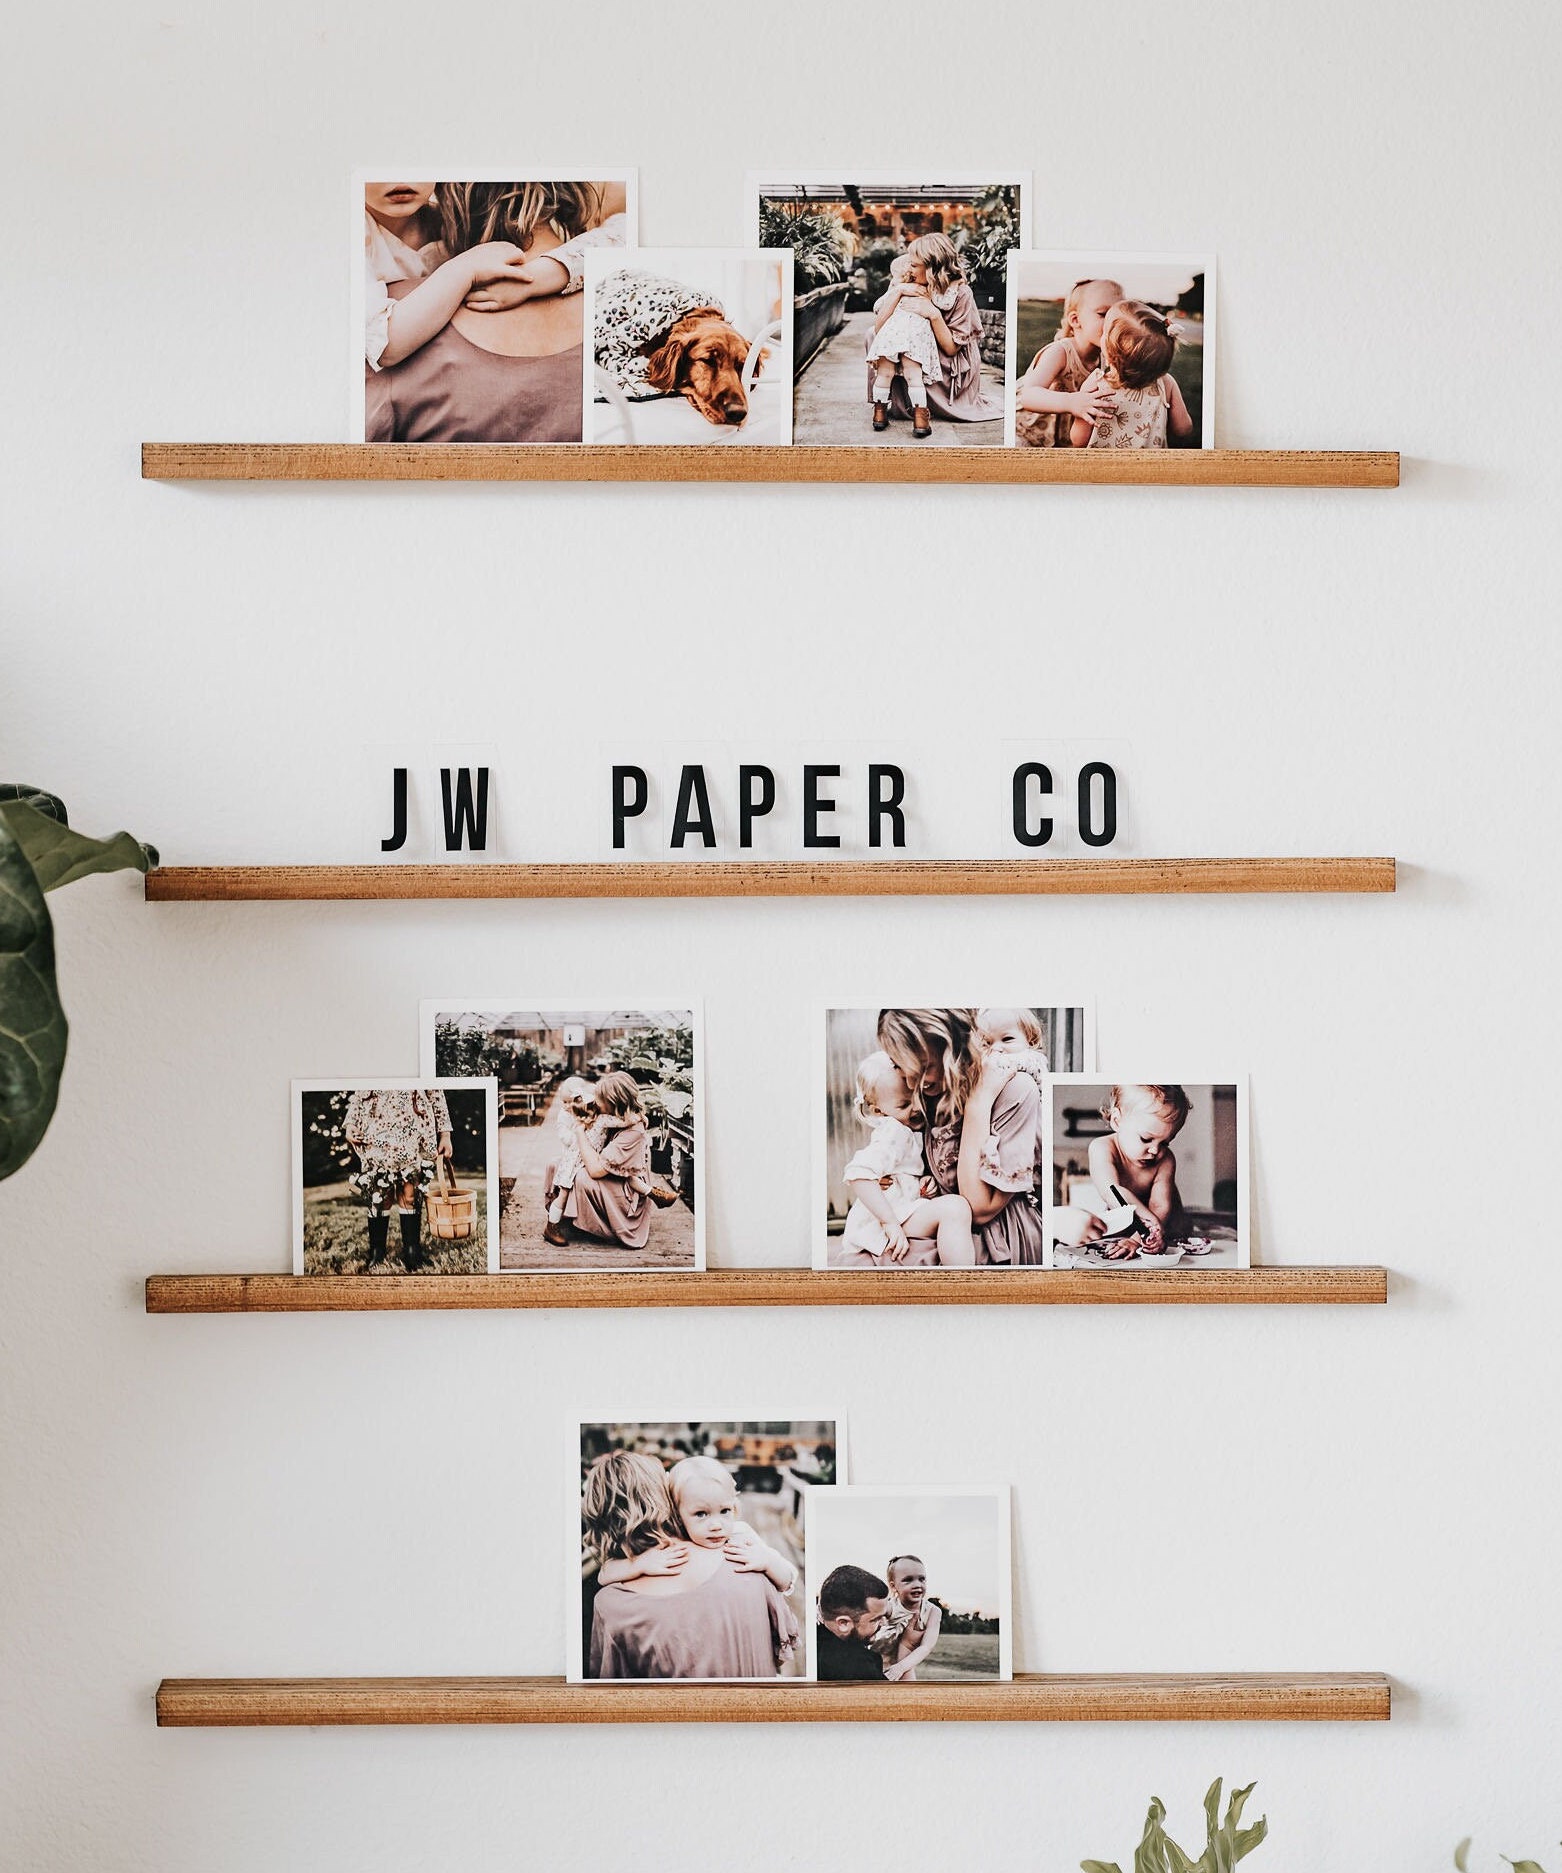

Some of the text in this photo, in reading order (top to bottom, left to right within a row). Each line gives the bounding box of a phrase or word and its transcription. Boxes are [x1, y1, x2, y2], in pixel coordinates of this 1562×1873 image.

[380, 761, 1117, 852] JW PAPER CO
